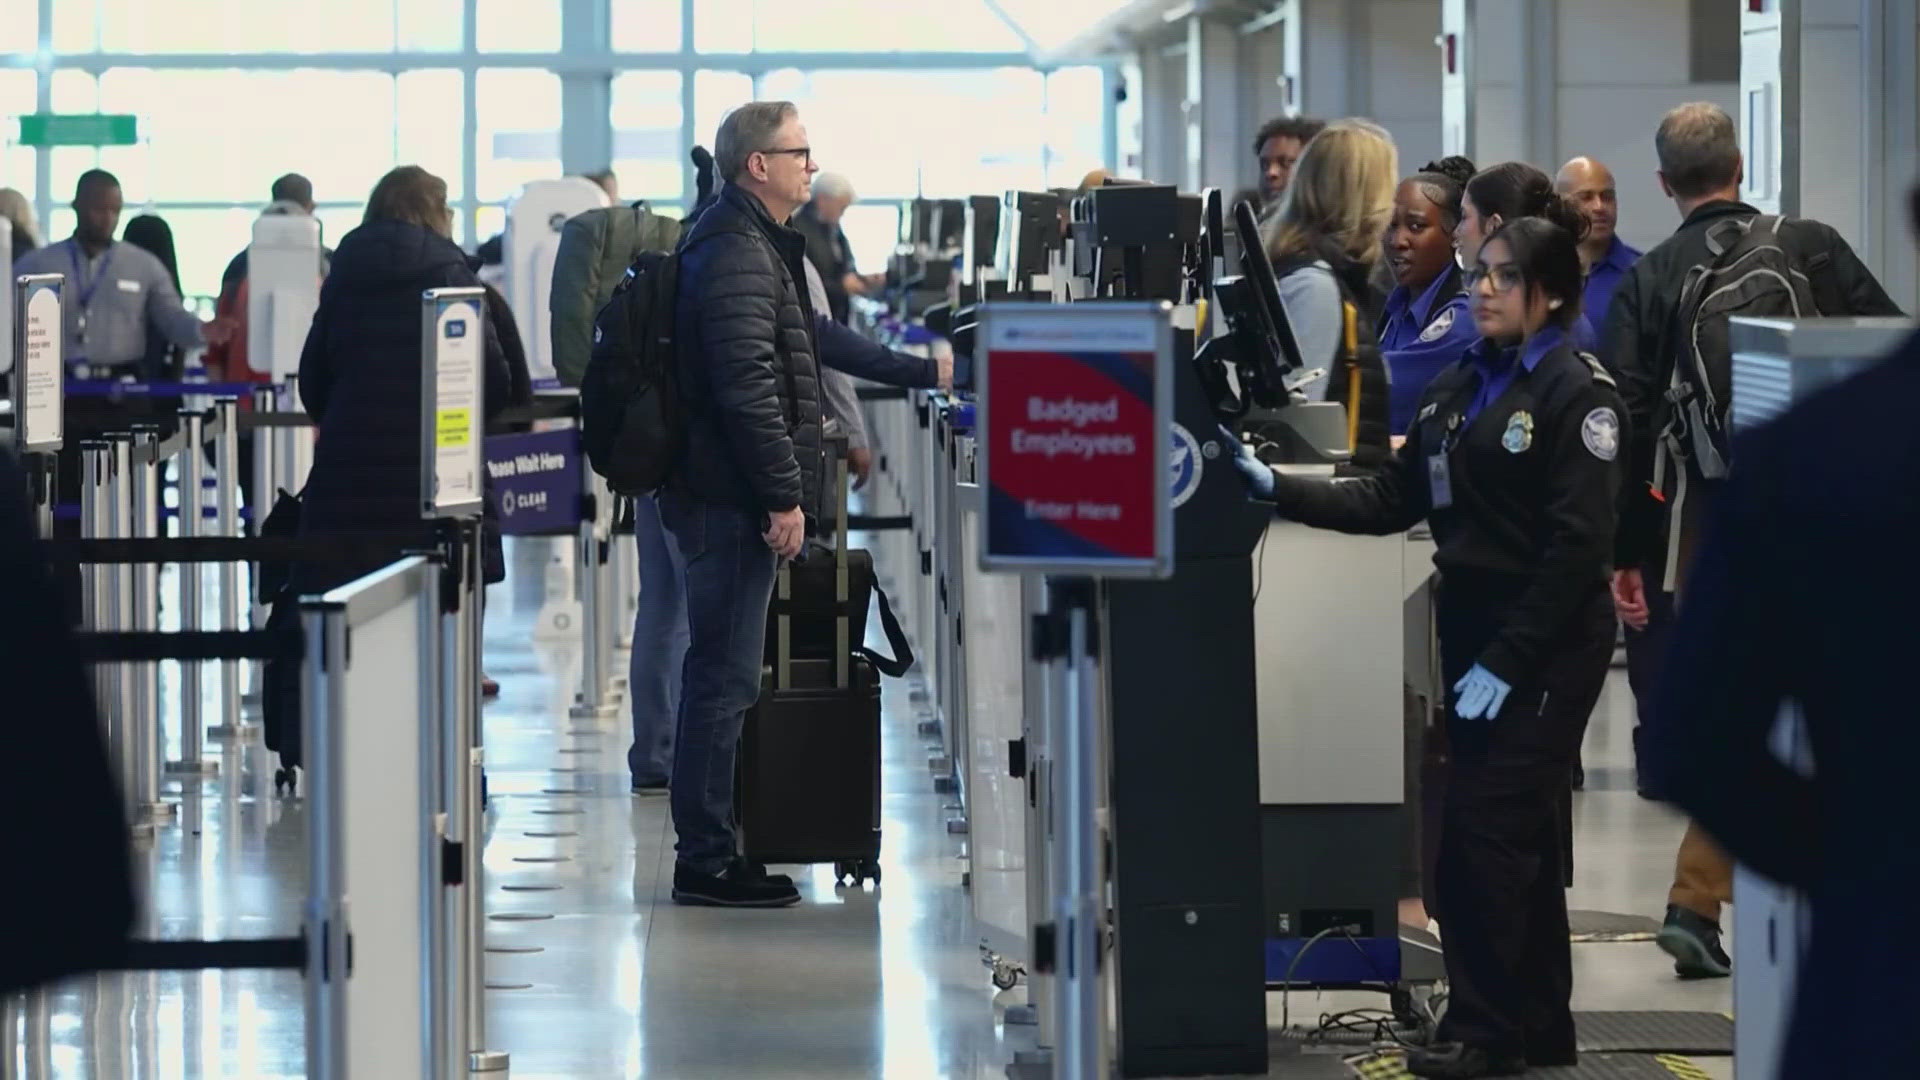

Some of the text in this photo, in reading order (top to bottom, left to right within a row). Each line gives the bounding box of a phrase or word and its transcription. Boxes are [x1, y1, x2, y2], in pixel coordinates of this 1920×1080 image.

[1028, 396, 1119, 426] Badged
[1011, 429, 1136, 461] Employees
[515, 454, 540, 474] Wait
[540, 453, 565, 470] Here
[517, 491, 546, 508] CLEAR
[1025, 500, 1122, 520] Enter Here
